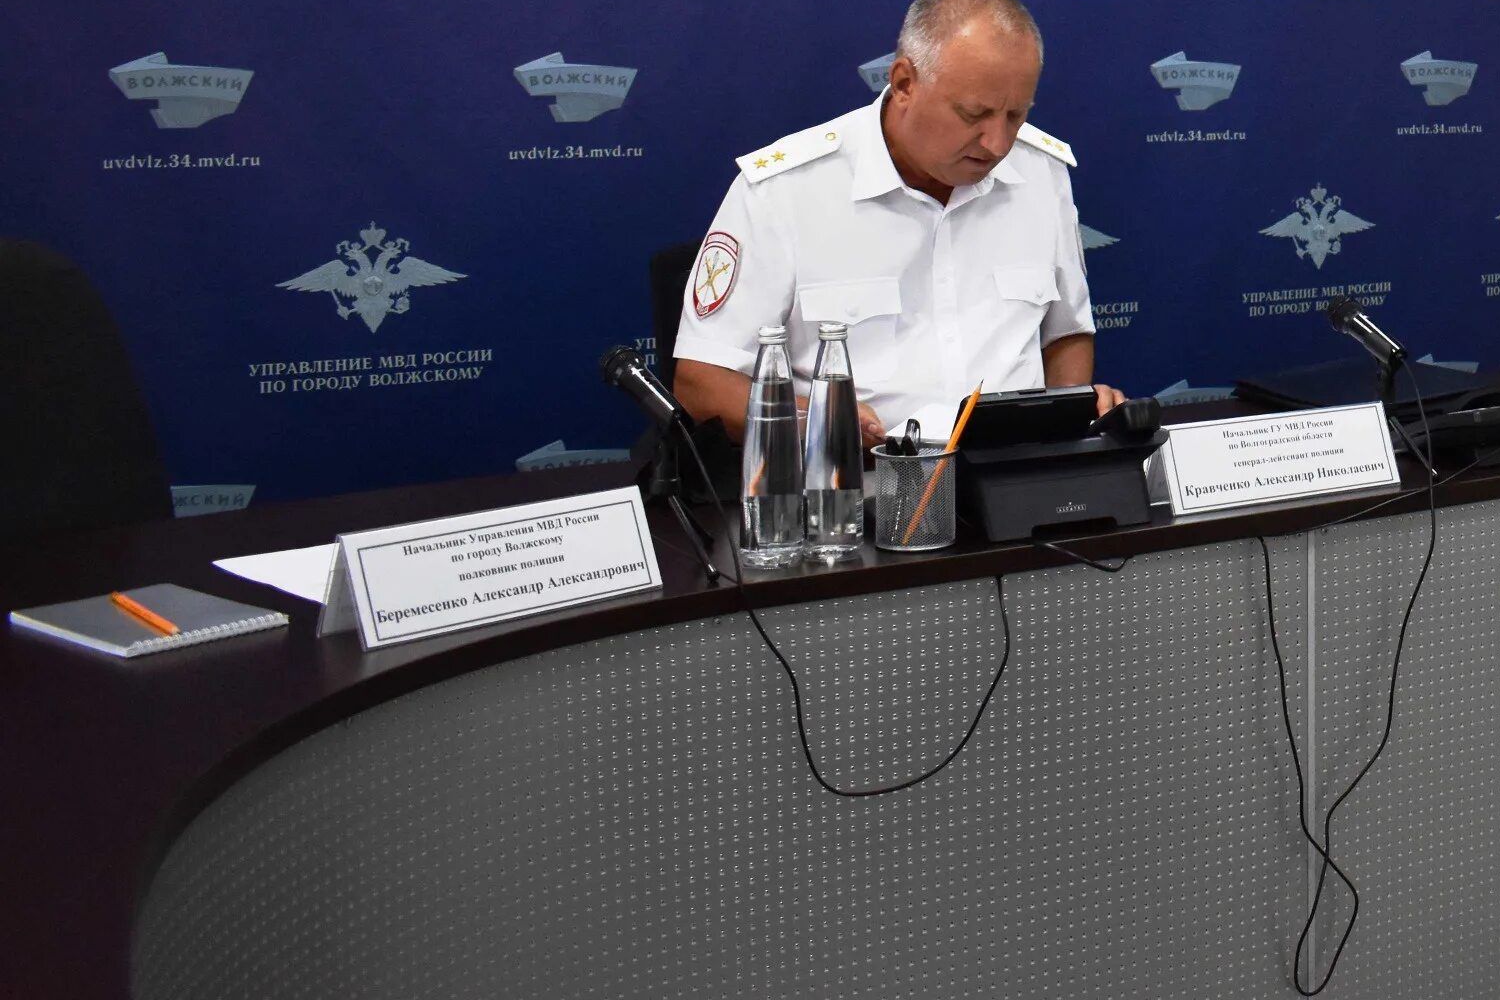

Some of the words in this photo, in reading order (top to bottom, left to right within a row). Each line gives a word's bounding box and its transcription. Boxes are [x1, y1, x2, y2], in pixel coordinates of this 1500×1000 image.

[127, 73, 243, 92] ВОЛЖСКИЙ
[529, 73, 627, 87] ВОЛЖСКИЙ
[1146, 130, 1246, 142] uvdvlz.34.mvd.ru
[1397, 123, 1482, 135] uvdvlz.34.mvd.ru
[103, 154, 260, 169] uvdvlz.34.mvd.ru
[509, 146, 642, 160] uvdvlz.34.mvd.ru
[1242, 287, 1318, 303] УПРАВЛЕНИЕ
[1321, 285, 1344, 297] МВД
[1347, 281, 1391, 294] РОССИИ
[1486, 285, 1500, 297] ПО
[1249, 305, 1265, 317] ПО
[1268, 301, 1311, 315] ГОРОДУ
[248, 357, 372, 377] УПРАВЛЕНИЕ
[378, 353, 417, 371] МВД
[422, 349, 493, 366] РОССИИ
[259, 378, 286, 393] ПО
[291, 373, 362, 391] ГОРОДУ
[368, 366, 484, 387] ВОЛЖСКОМУ
[1222, 425, 1269, 439] Начальник
[1270, 423, 1283, 434] ГУ
[1285, 421, 1305, 432] МВД
[1306, 419, 1334, 429] России
[1310, 447, 1344, 460] полиции
[1185, 477, 1251, 498] Кравченко
[1254, 469, 1315, 488] Александр
[1317, 460, 1385, 479] Николаевич
[174, 492, 244, 507] ЖСКИЙ
[402, 537, 466, 556] Начальник
[468, 524, 534, 545] Управления
[536, 518, 563, 533] МВД
[565, 511, 600, 527] России
[451, 553, 462, 564] по
[464, 545, 502, 563] городу
[504, 534, 563, 553] Волжскому
[458, 562, 518, 582] полковник
[520, 553, 565, 570] полиции
[376, 596, 468, 625] Беремесенко
[470, 580, 544, 605] Александр
[547, 561, 646, 589] Александрович
